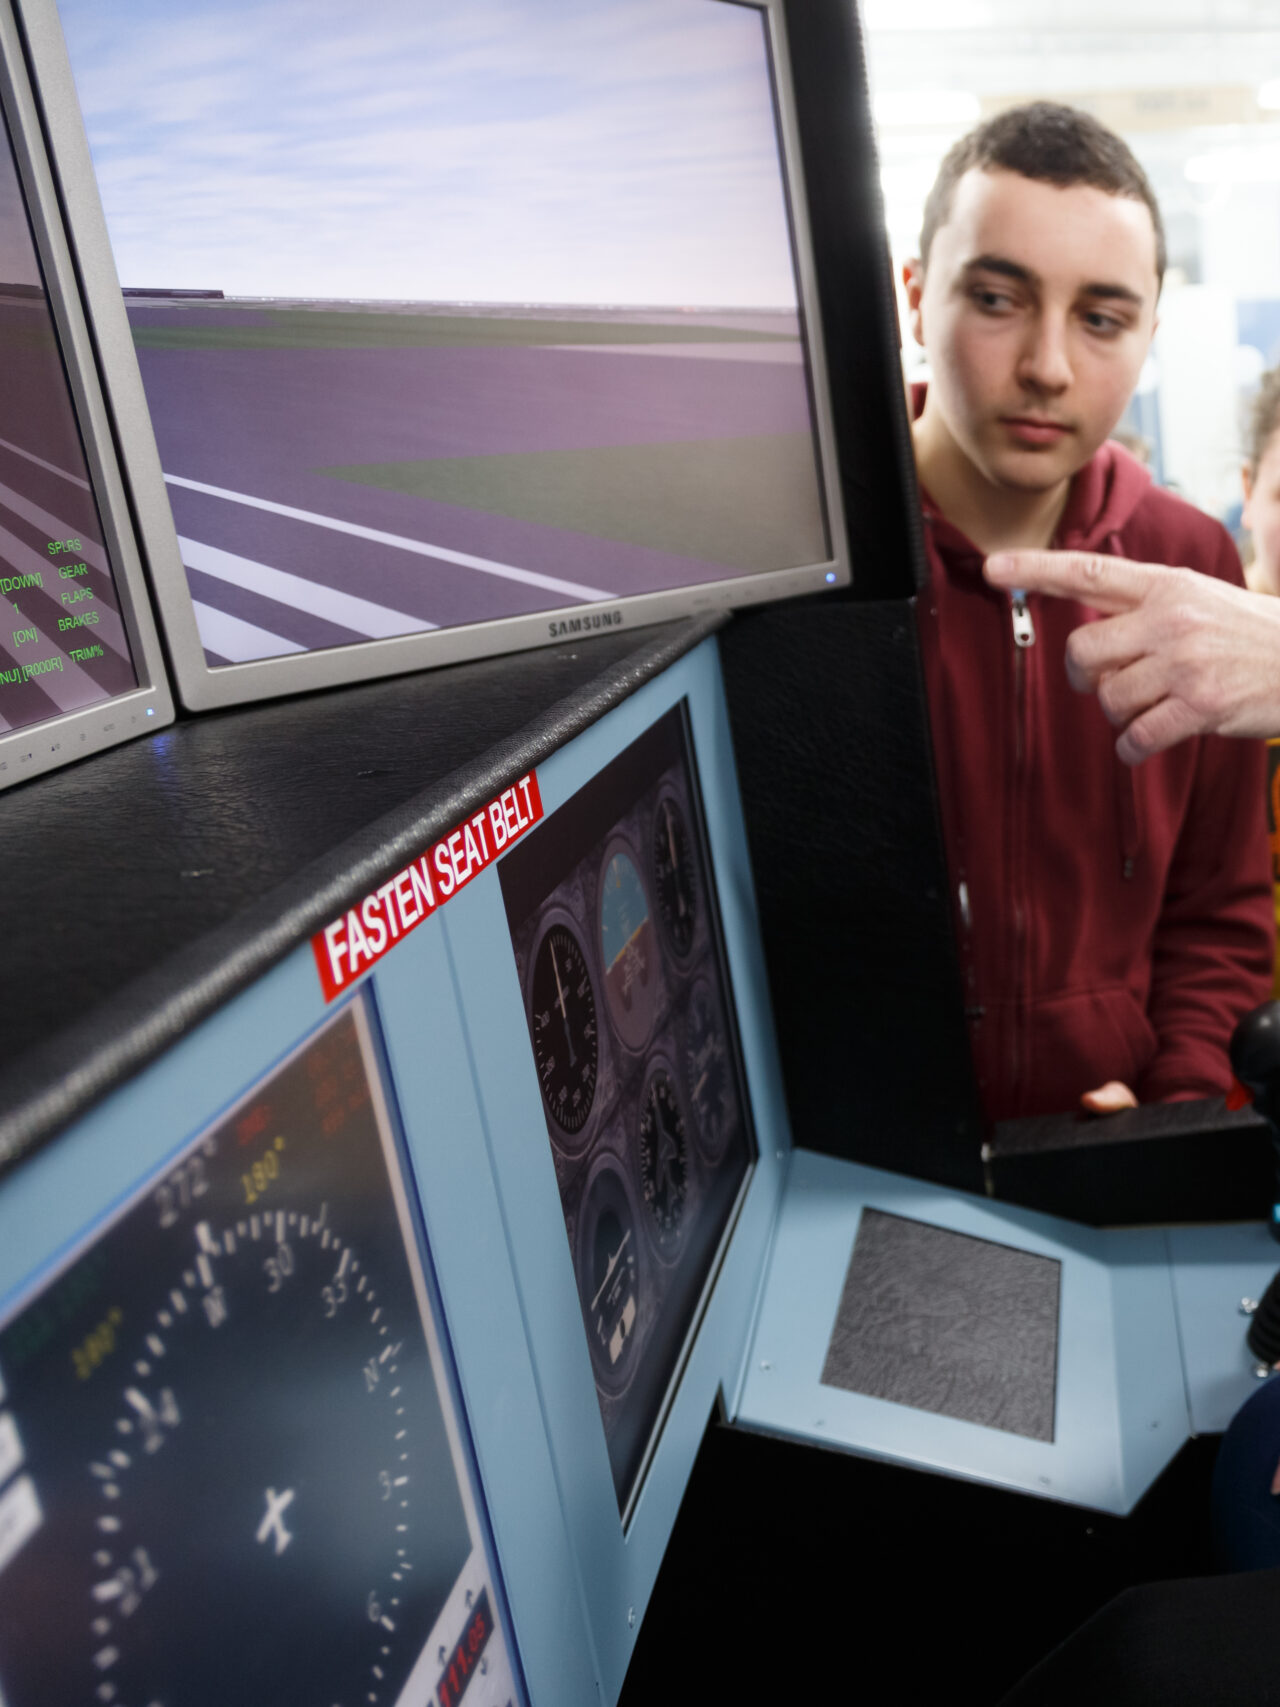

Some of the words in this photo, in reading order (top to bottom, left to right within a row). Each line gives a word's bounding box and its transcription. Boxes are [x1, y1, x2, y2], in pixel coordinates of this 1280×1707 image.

[47, 538, 82, 555] SPLRS
[0, 572, 43, 595] [DOWN]
[58, 563, 88, 579] GEAR
[13, 602, 20, 615] 1
[61, 587, 94, 605] FLAPS
[13, 627, 38, 647] [ON]
[58, 611, 99, 631] BRAKES
[548, 610, 623, 638] SAMSUNG
[324, 856, 435, 985] FASTEN
[434, 811, 489, 896] SEAT
[489, 775, 535, 850] BELT
